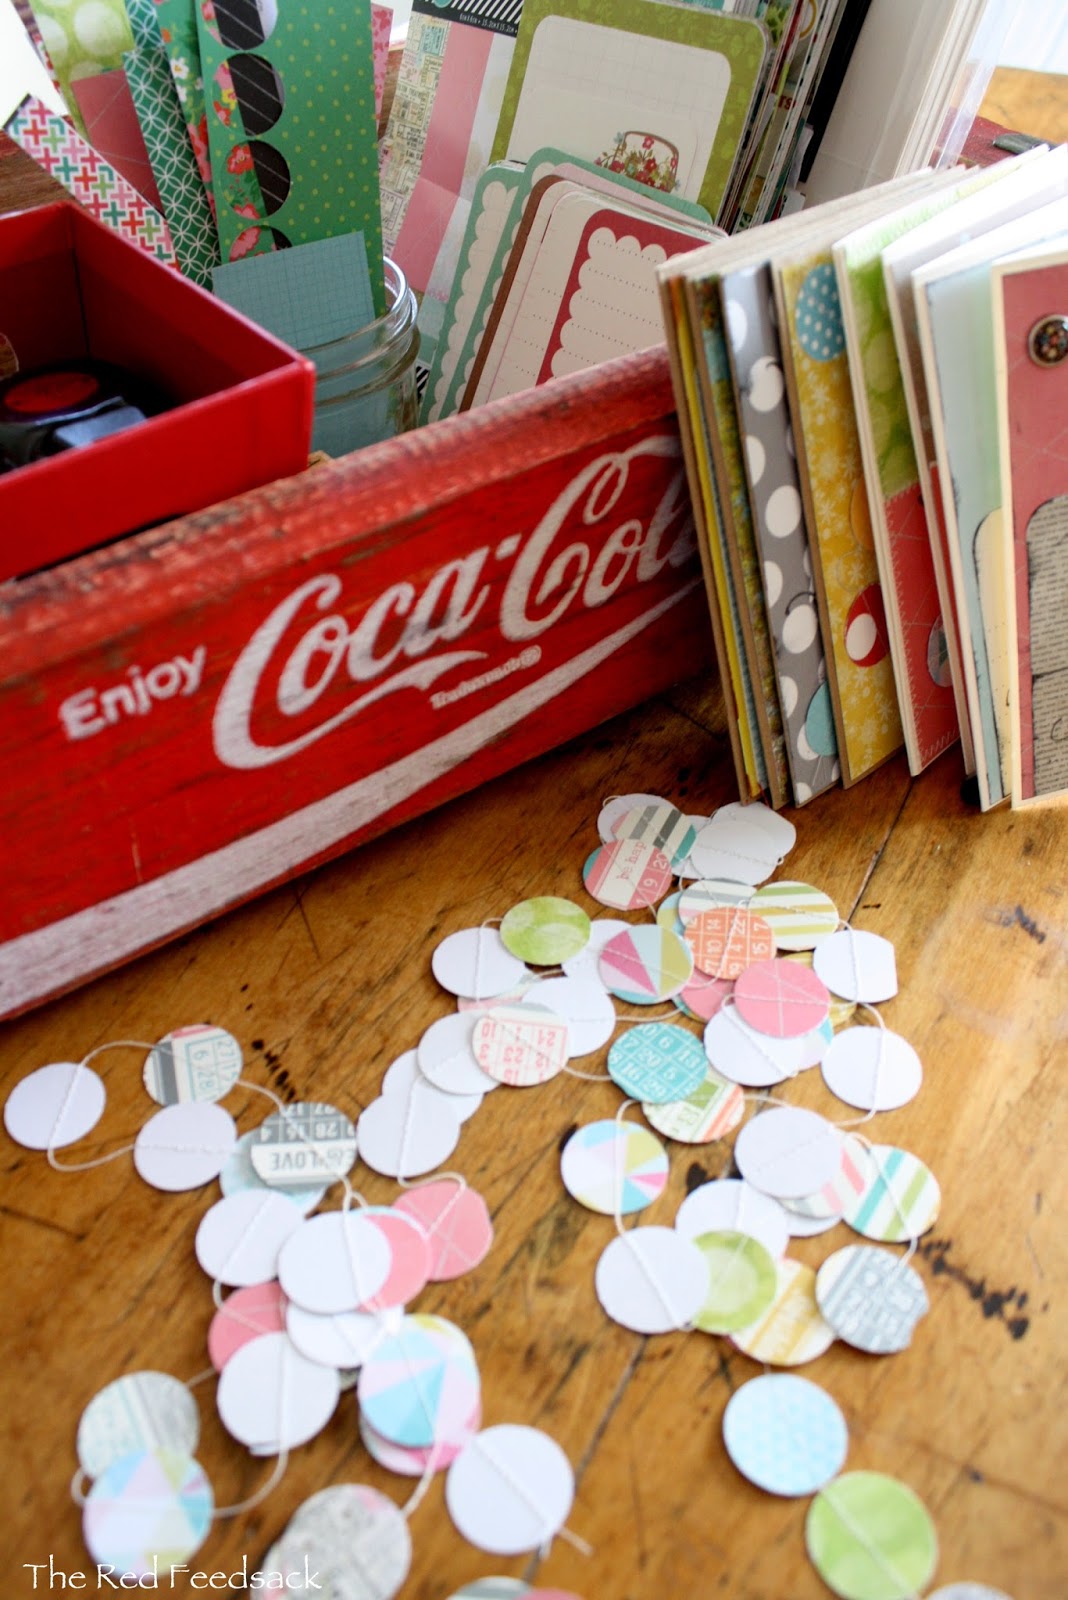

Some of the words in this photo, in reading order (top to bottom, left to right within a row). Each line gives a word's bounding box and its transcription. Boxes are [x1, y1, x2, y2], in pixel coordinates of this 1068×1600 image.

[58, 645, 207, 742] Enjoy
[481, 1021, 497, 1040] 10
[271, 1149, 317, 1171] LOVE
